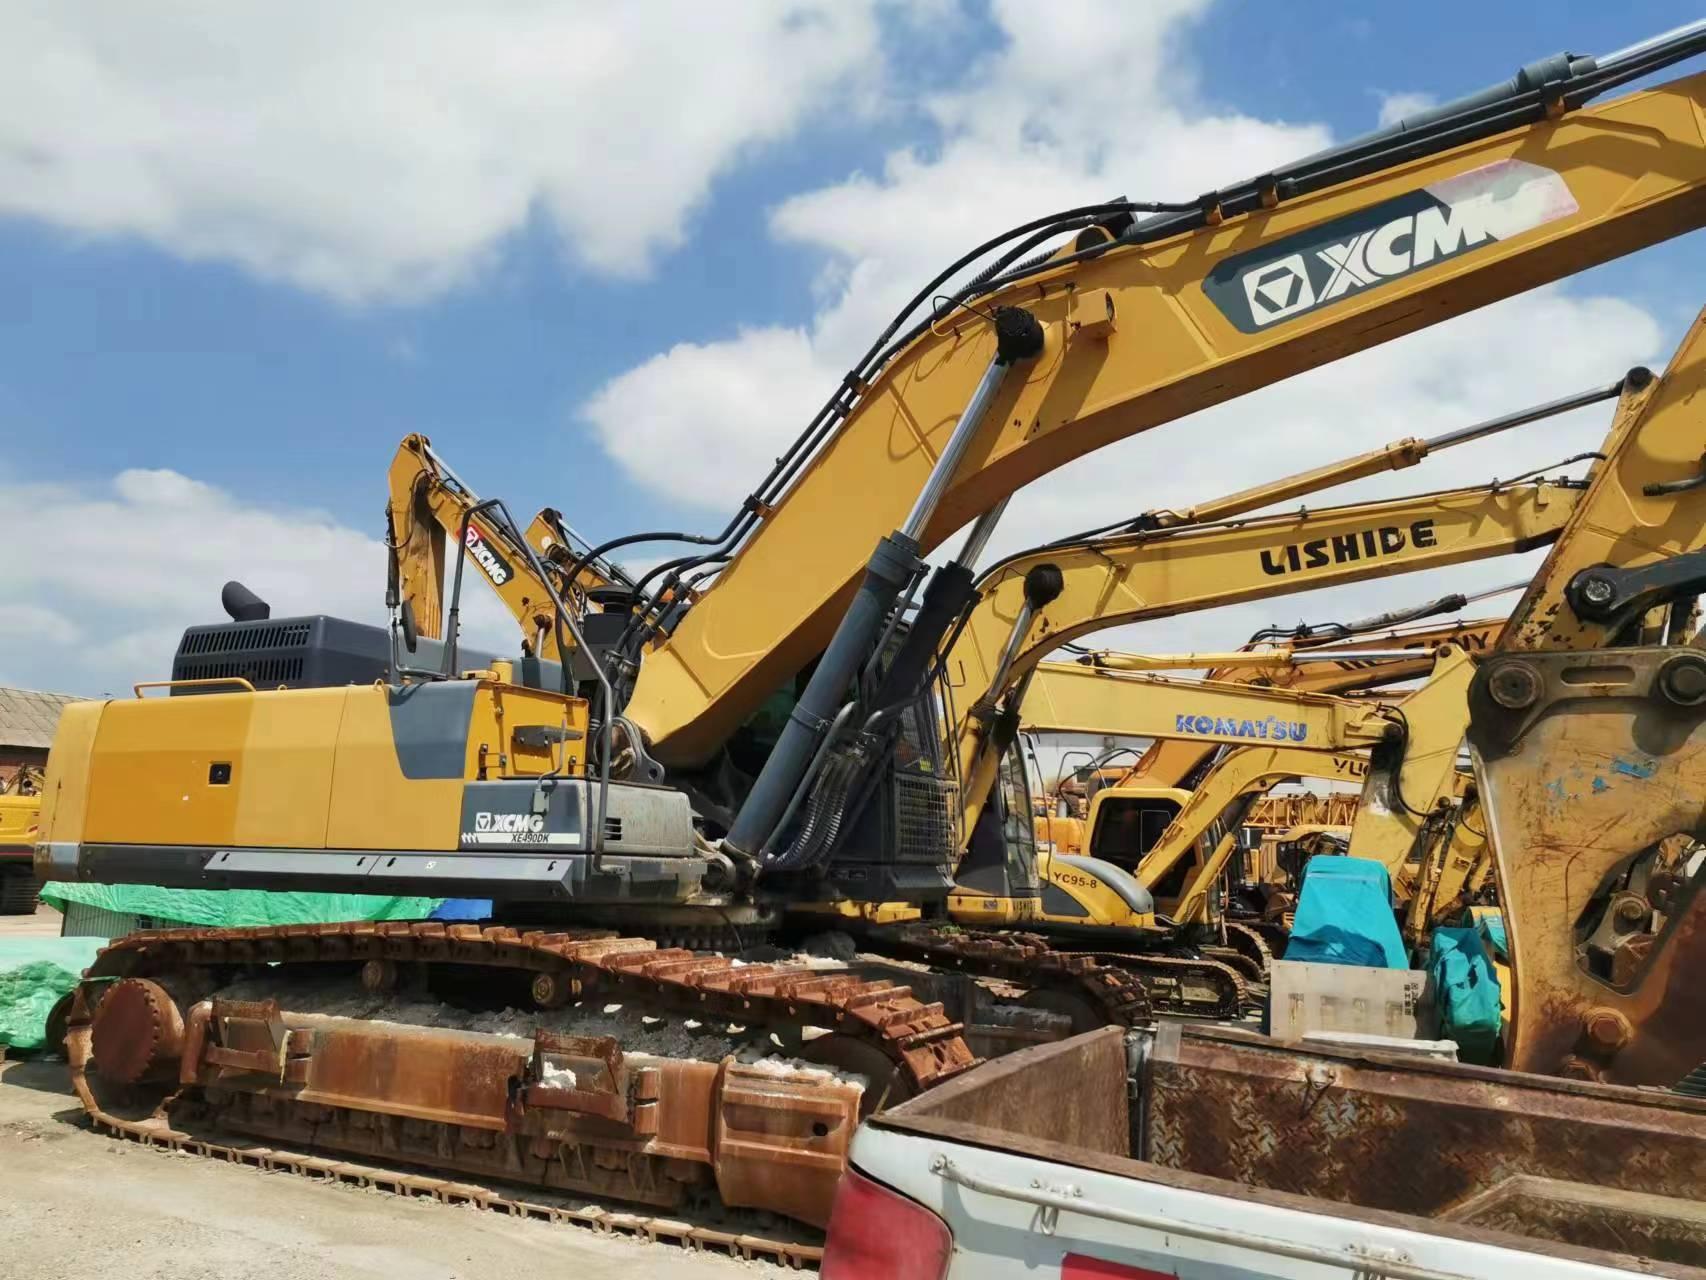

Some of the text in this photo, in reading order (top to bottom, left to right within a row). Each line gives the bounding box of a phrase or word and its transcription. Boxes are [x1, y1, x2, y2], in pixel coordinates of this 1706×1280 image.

[1316, 202, 1488, 304] XCM
[1260, 519, 1438, 576] LISHIDE
[472, 540, 507, 585] XCMG
[1176, 714, 1307, 742] KOMATSU
[1334, 757, 1370, 777] YU
[491, 814, 544, 833] XCMG
[511, 833, 549, 843] XE490DK
[1054, 872, 1097, 889] YC95-8
